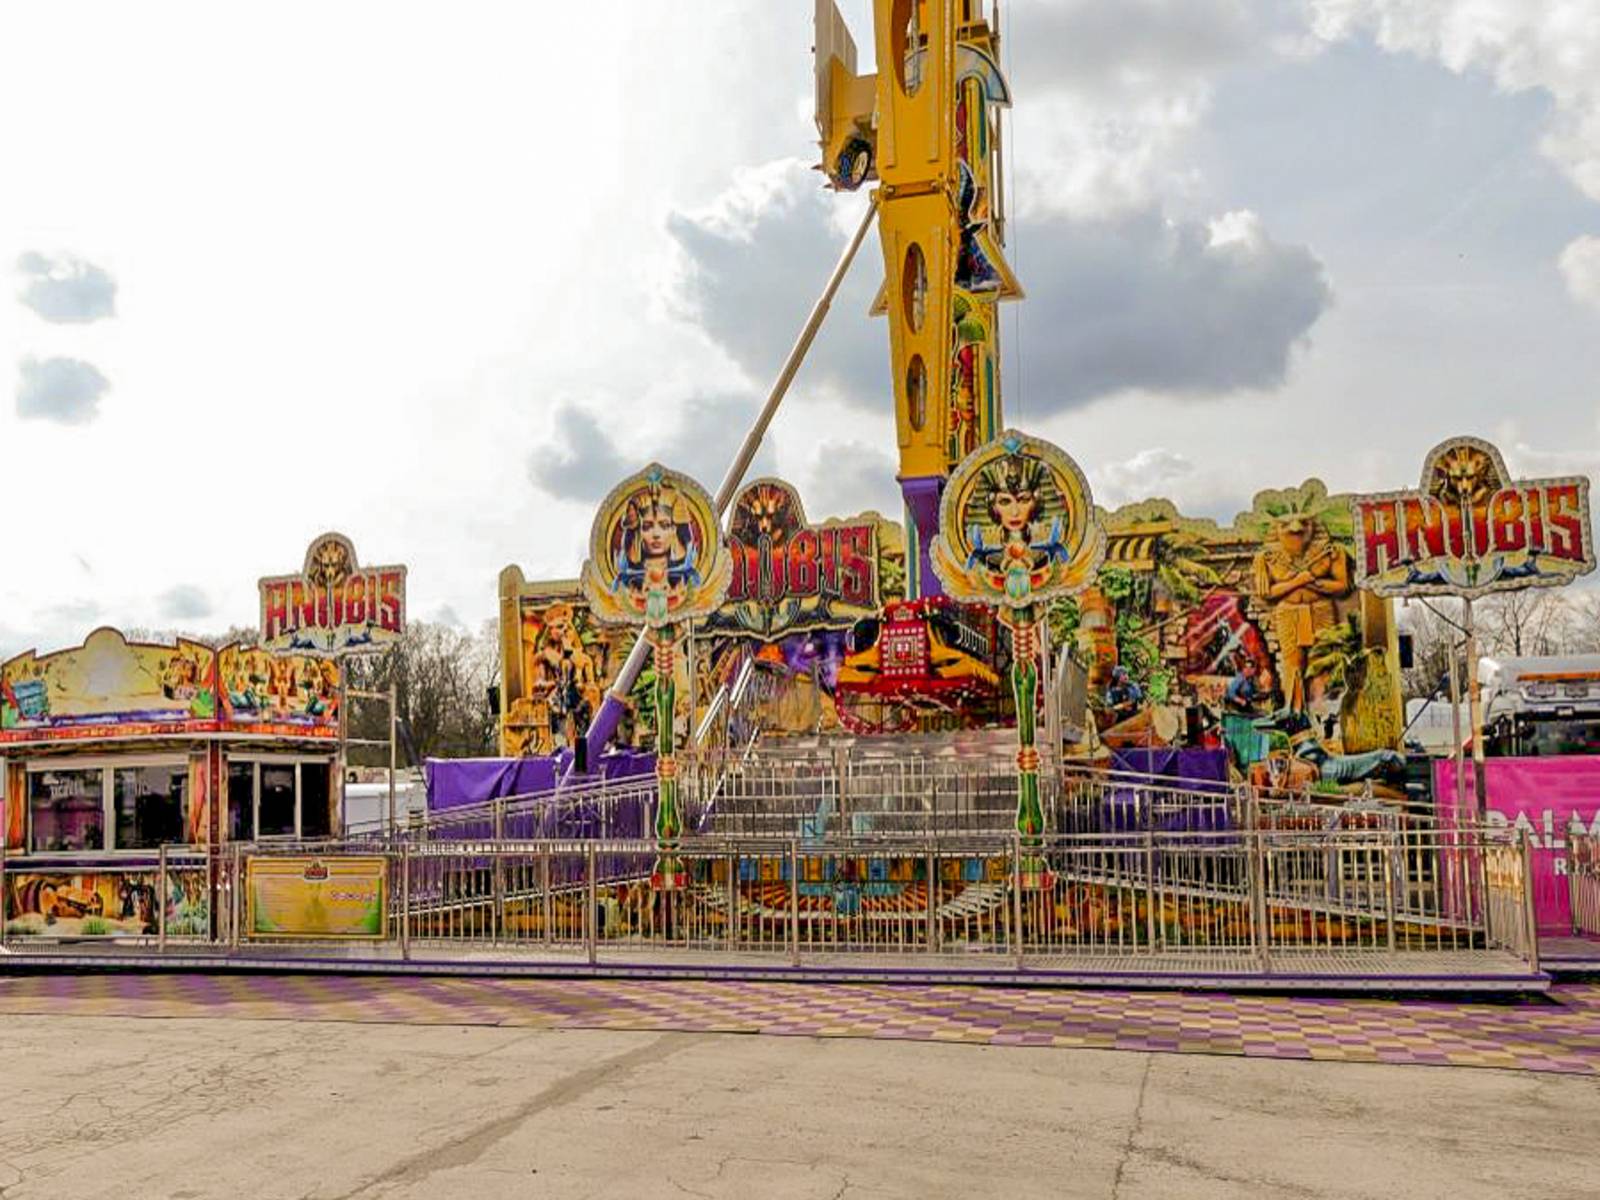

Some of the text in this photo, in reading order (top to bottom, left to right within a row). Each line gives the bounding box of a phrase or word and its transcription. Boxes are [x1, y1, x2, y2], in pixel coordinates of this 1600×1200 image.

[728, 525, 874, 605] UBIS
[1360, 484, 1587, 577] ANUBIS
[264, 572, 402, 642] ANUBIS
